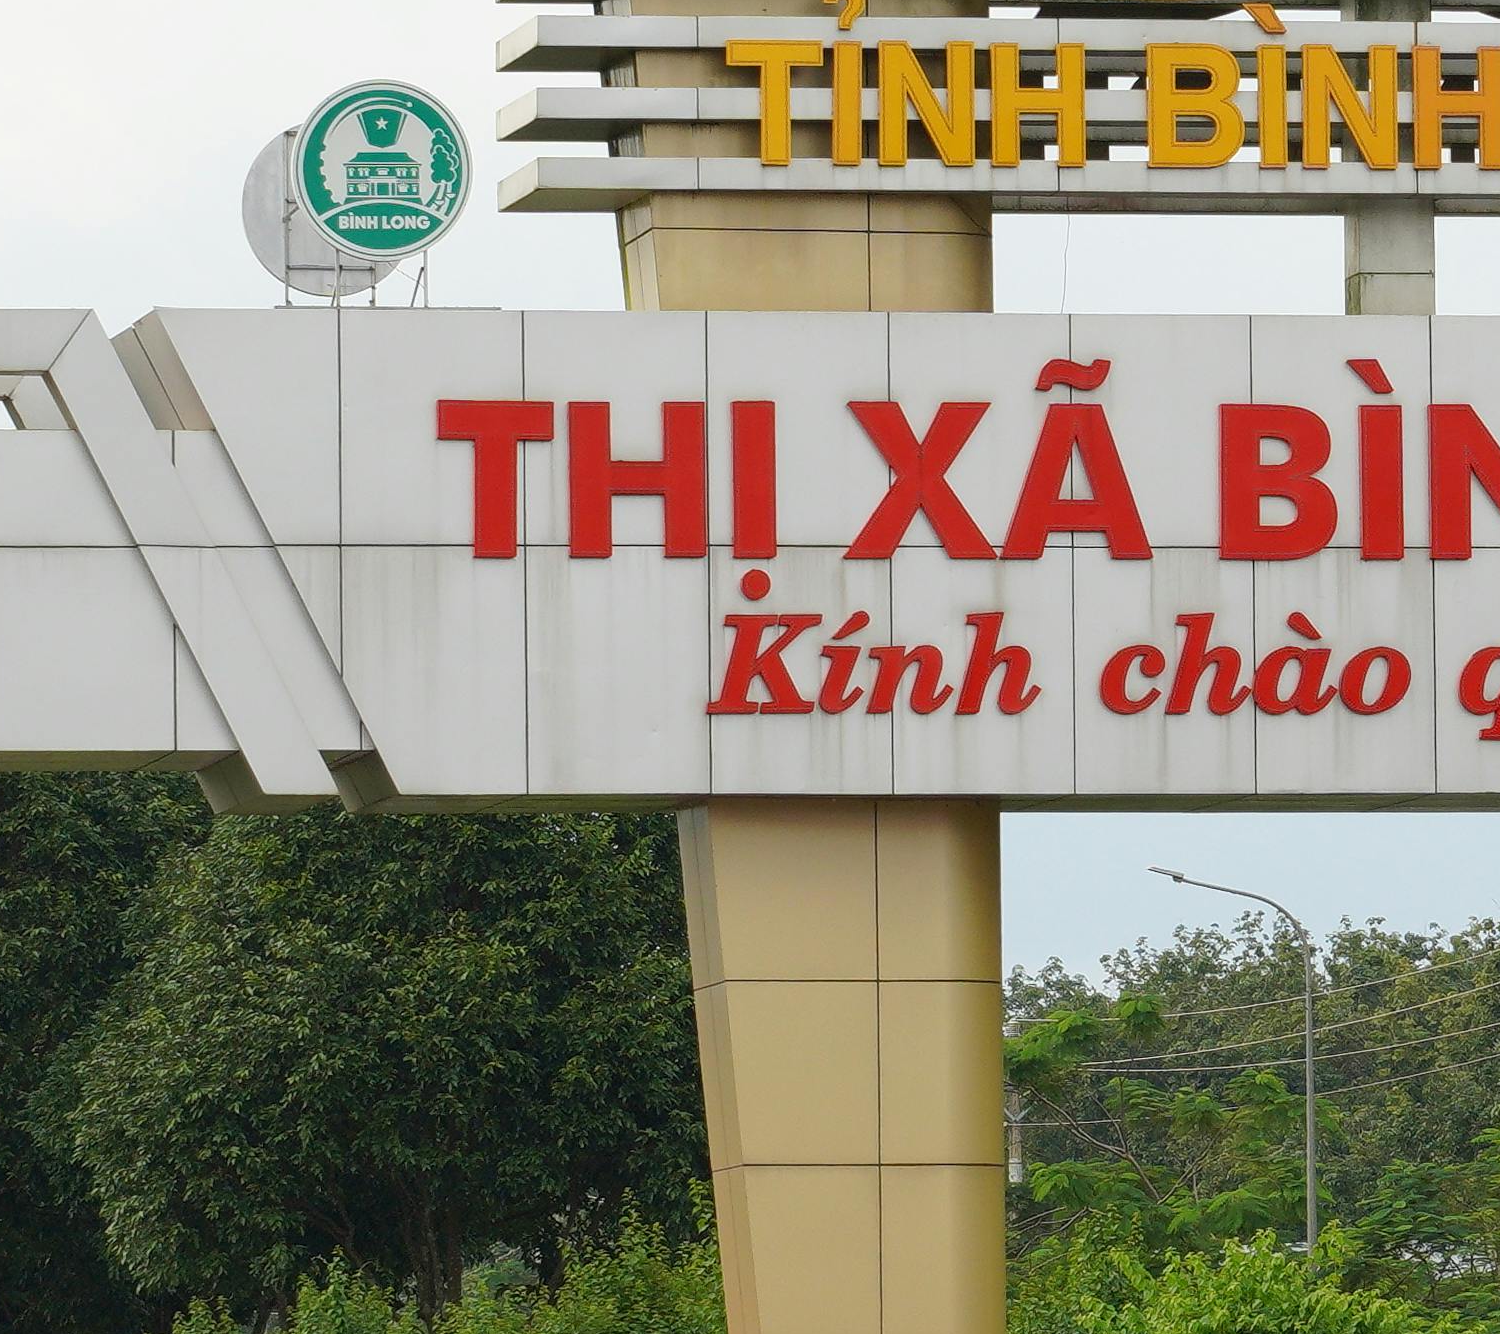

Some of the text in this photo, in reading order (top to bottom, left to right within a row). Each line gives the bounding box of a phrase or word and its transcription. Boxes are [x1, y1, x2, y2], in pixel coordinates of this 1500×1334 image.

[338, 211, 431, 230] BÌNH LONG
[436, 399, 779, 601] THỊ
[842, 358, 1154, 561] XÃ
[706, 610, 1042, 715] Kính
[1099, 611, 1412, 716] chào
